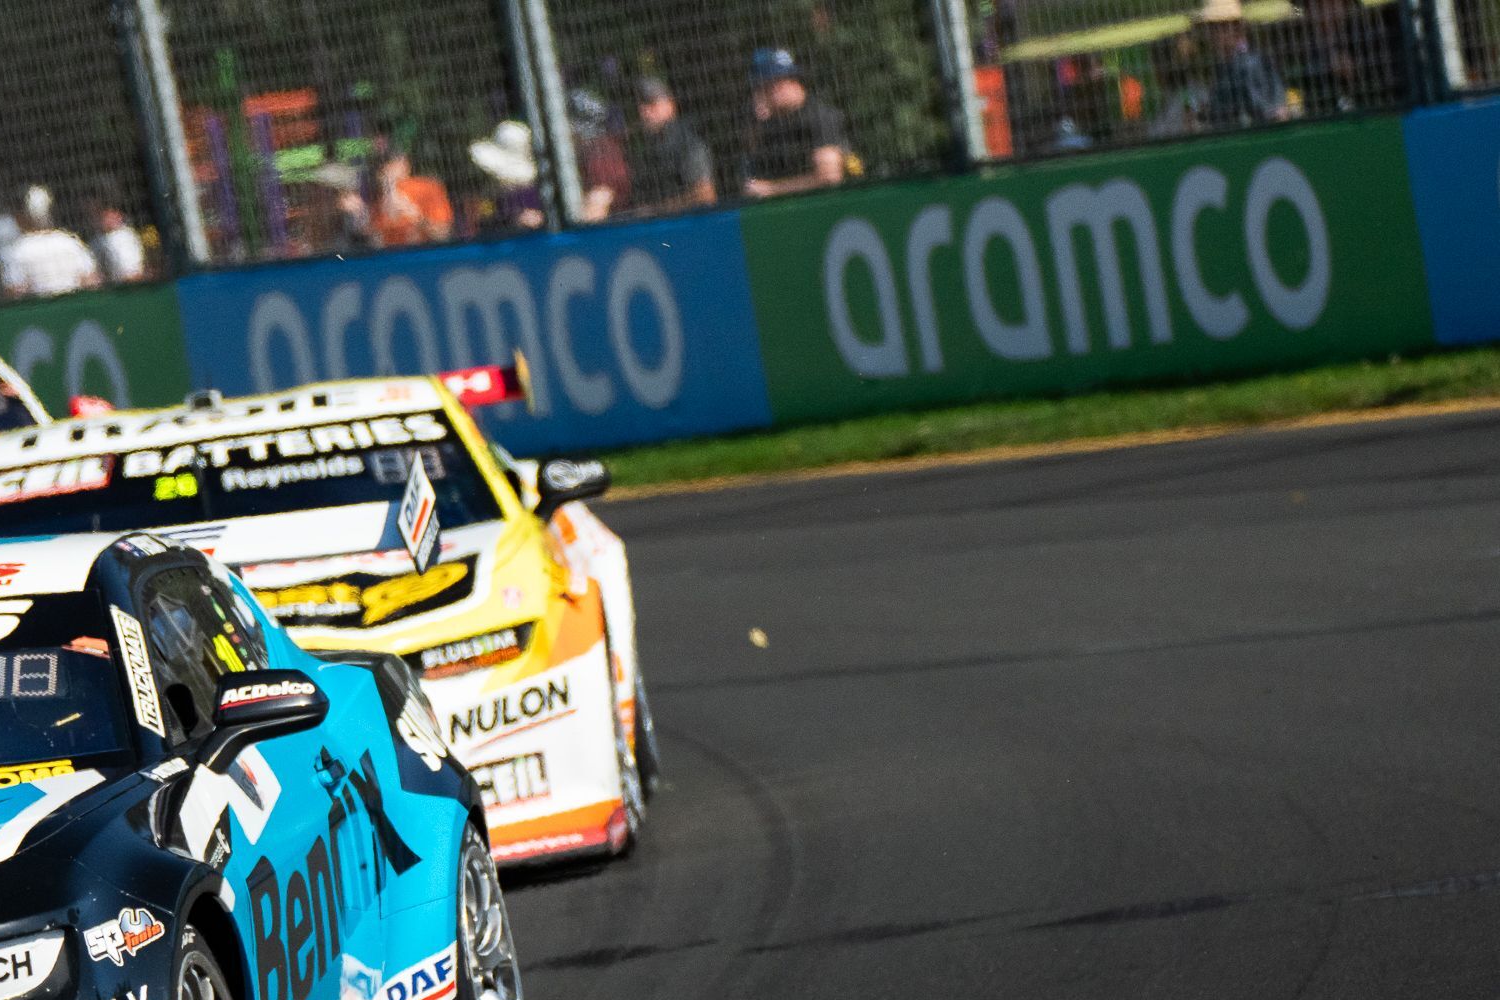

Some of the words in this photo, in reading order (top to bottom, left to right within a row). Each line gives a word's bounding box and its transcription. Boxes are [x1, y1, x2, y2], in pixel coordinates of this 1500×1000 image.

[822, 156, 1332, 379] aramco
[123, 412, 447, 478] BATTERIES
[220, 456, 365, 491] Reynolds
[116, 610, 160, 731] TRUCKMATE
[220, 680, 316, 705] ACDelco
[449, 675, 570, 743] NULON
